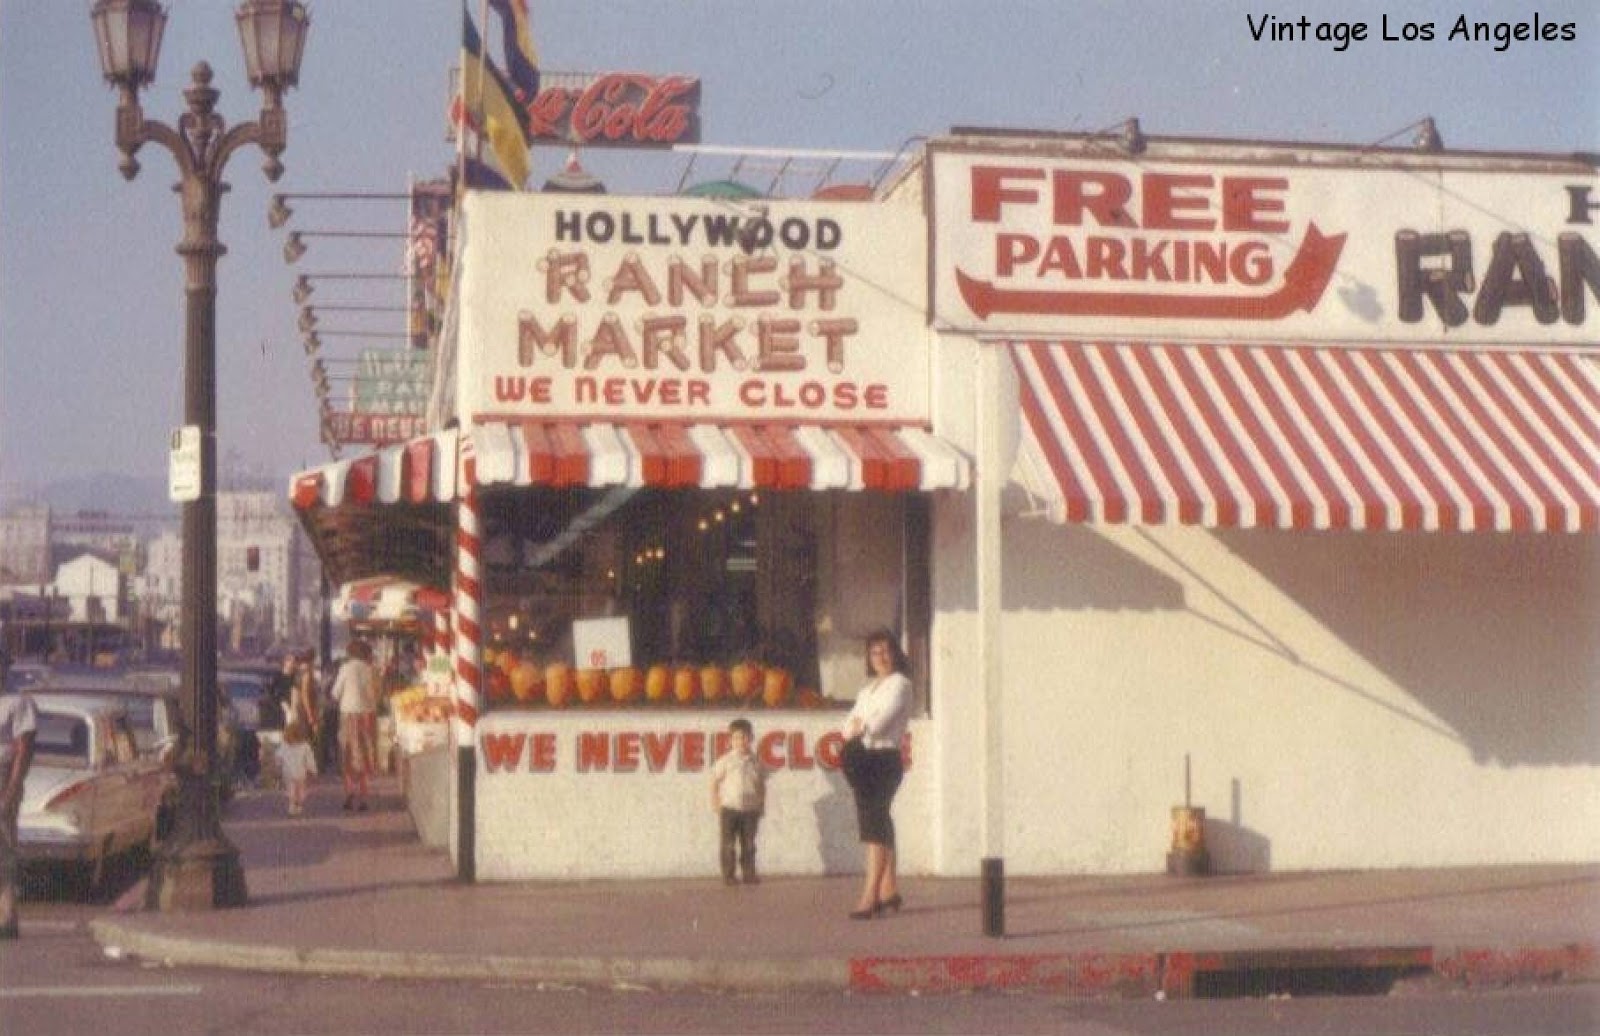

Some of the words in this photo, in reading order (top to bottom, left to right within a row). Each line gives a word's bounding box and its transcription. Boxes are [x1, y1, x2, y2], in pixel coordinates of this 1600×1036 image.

[969, 165, 1290, 233] FREE
[555, 209, 842, 252] HOLLYWOOD
[536, 249, 843, 311] RANCH
[995, 231, 1274, 287] PARKING
[517, 309, 858, 375] MARKET
[495, 375, 553, 404] WE
[575, 376, 710, 405] NEVER
[739, 380, 889, 409] CLOSE
[481, 732, 557, 773] WE
[757, 730, 912, 771] CLO
